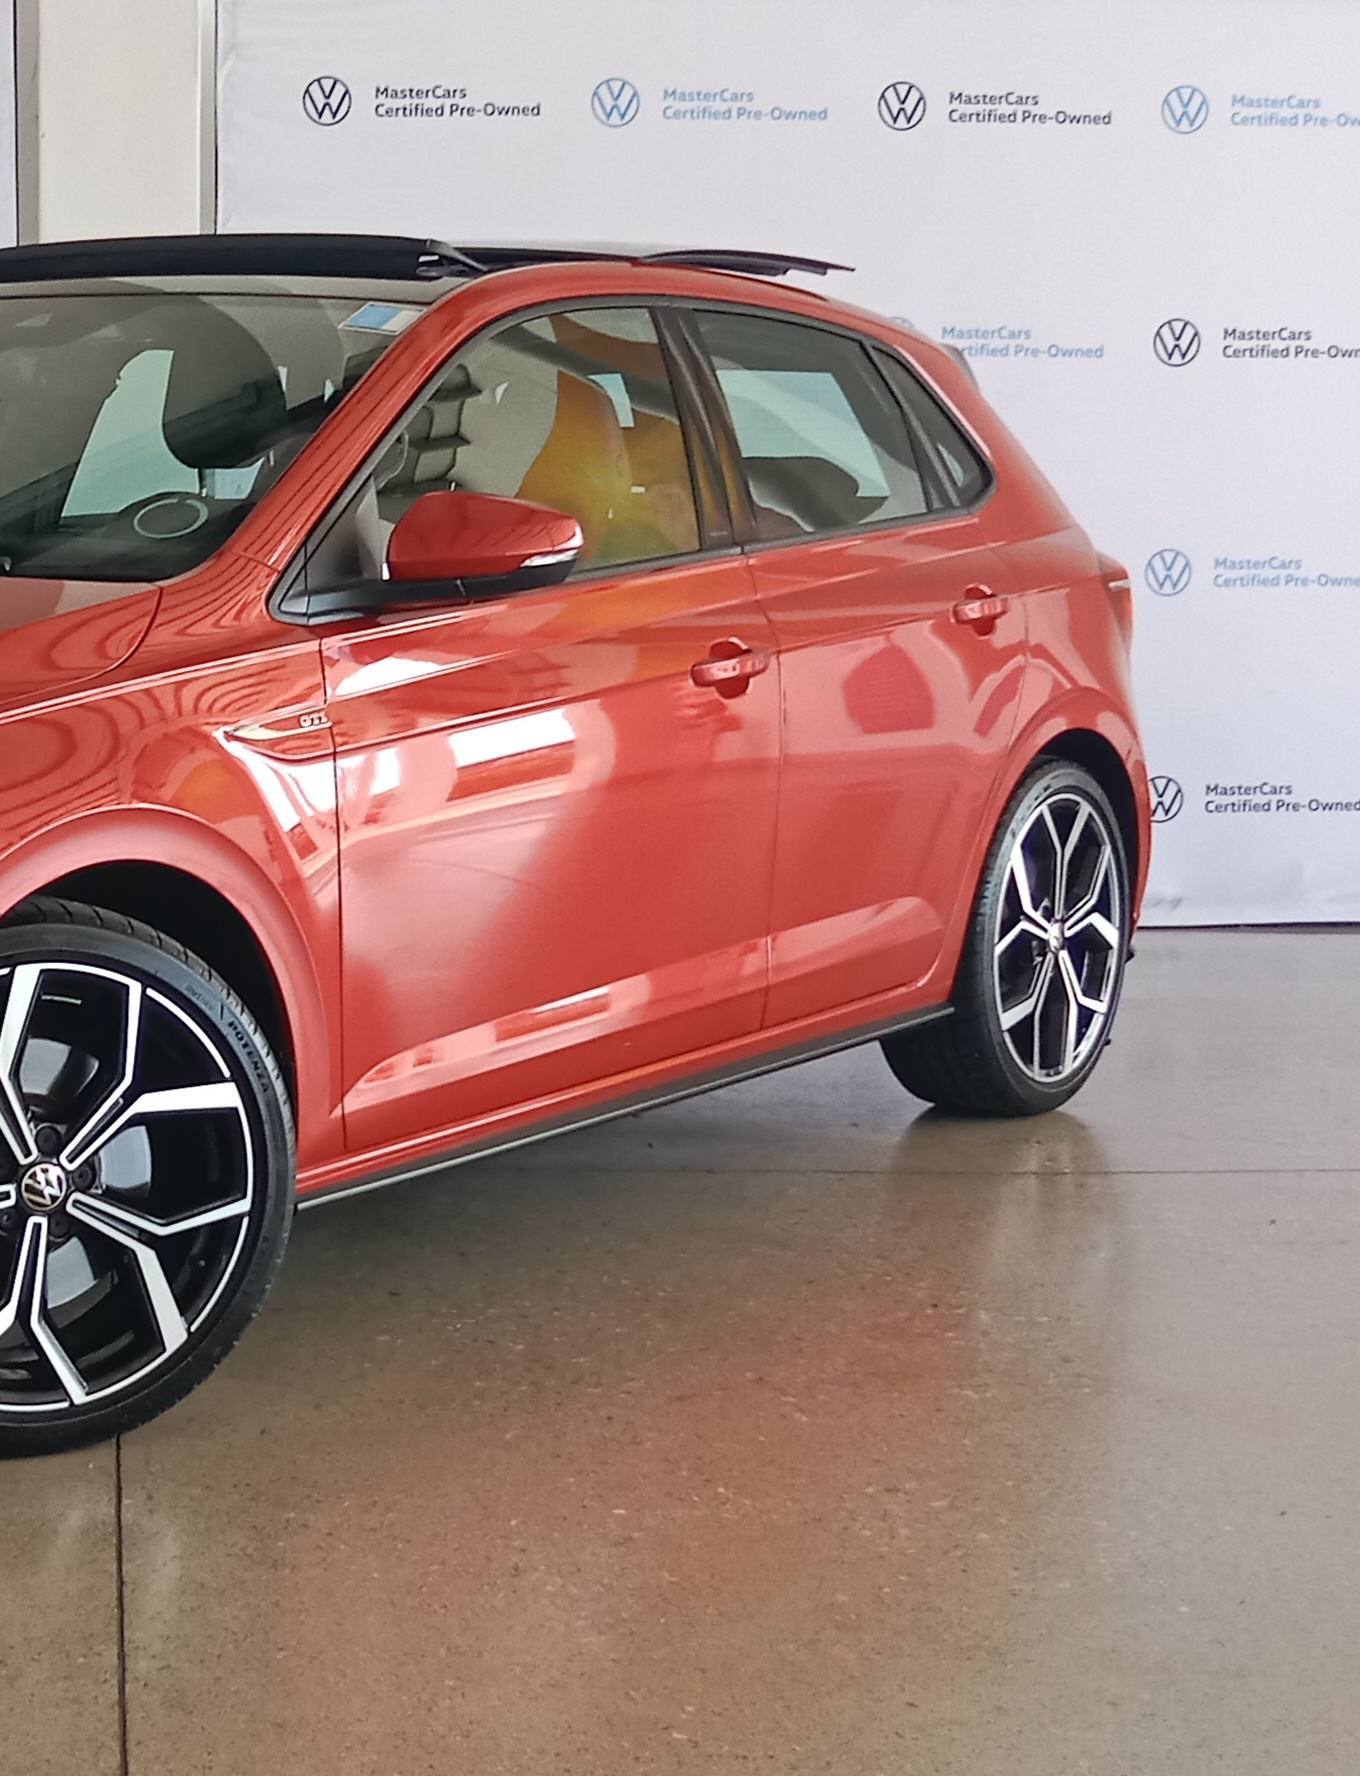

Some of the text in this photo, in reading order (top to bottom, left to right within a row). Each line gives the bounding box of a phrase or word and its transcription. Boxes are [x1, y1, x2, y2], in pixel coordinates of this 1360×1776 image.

[375, 85, 466, 99] MasterCars
[663, 88, 754, 103] MasterCars
[949, 92, 1039, 106] MasterCars
[1231, 94, 1321, 109] MasterCars
[375, 102, 540, 117] Certified Pre-Owned
[662, 105, 828, 122] Certified Pre-Owned
[948, 109, 1112, 125] Certified Pre-Owned
[1230, 112, 1360, 127] Certified Pre-Ow
[942, 326, 1031, 340] MasterCars
[1223, 327, 1312, 341] MasterCars
[958, 343, 1104, 359] rtified Pre-Owned
[1222, 344, 1360, 359] Certified Pre-Own
[1214, 556, 1302, 570] MasterCars
[1213, 573, 1360, 588] Certified Pre-Owne
[1205, 782, 1292, 796] MasterCars
[1205, 799, 1271, 813] Certified
